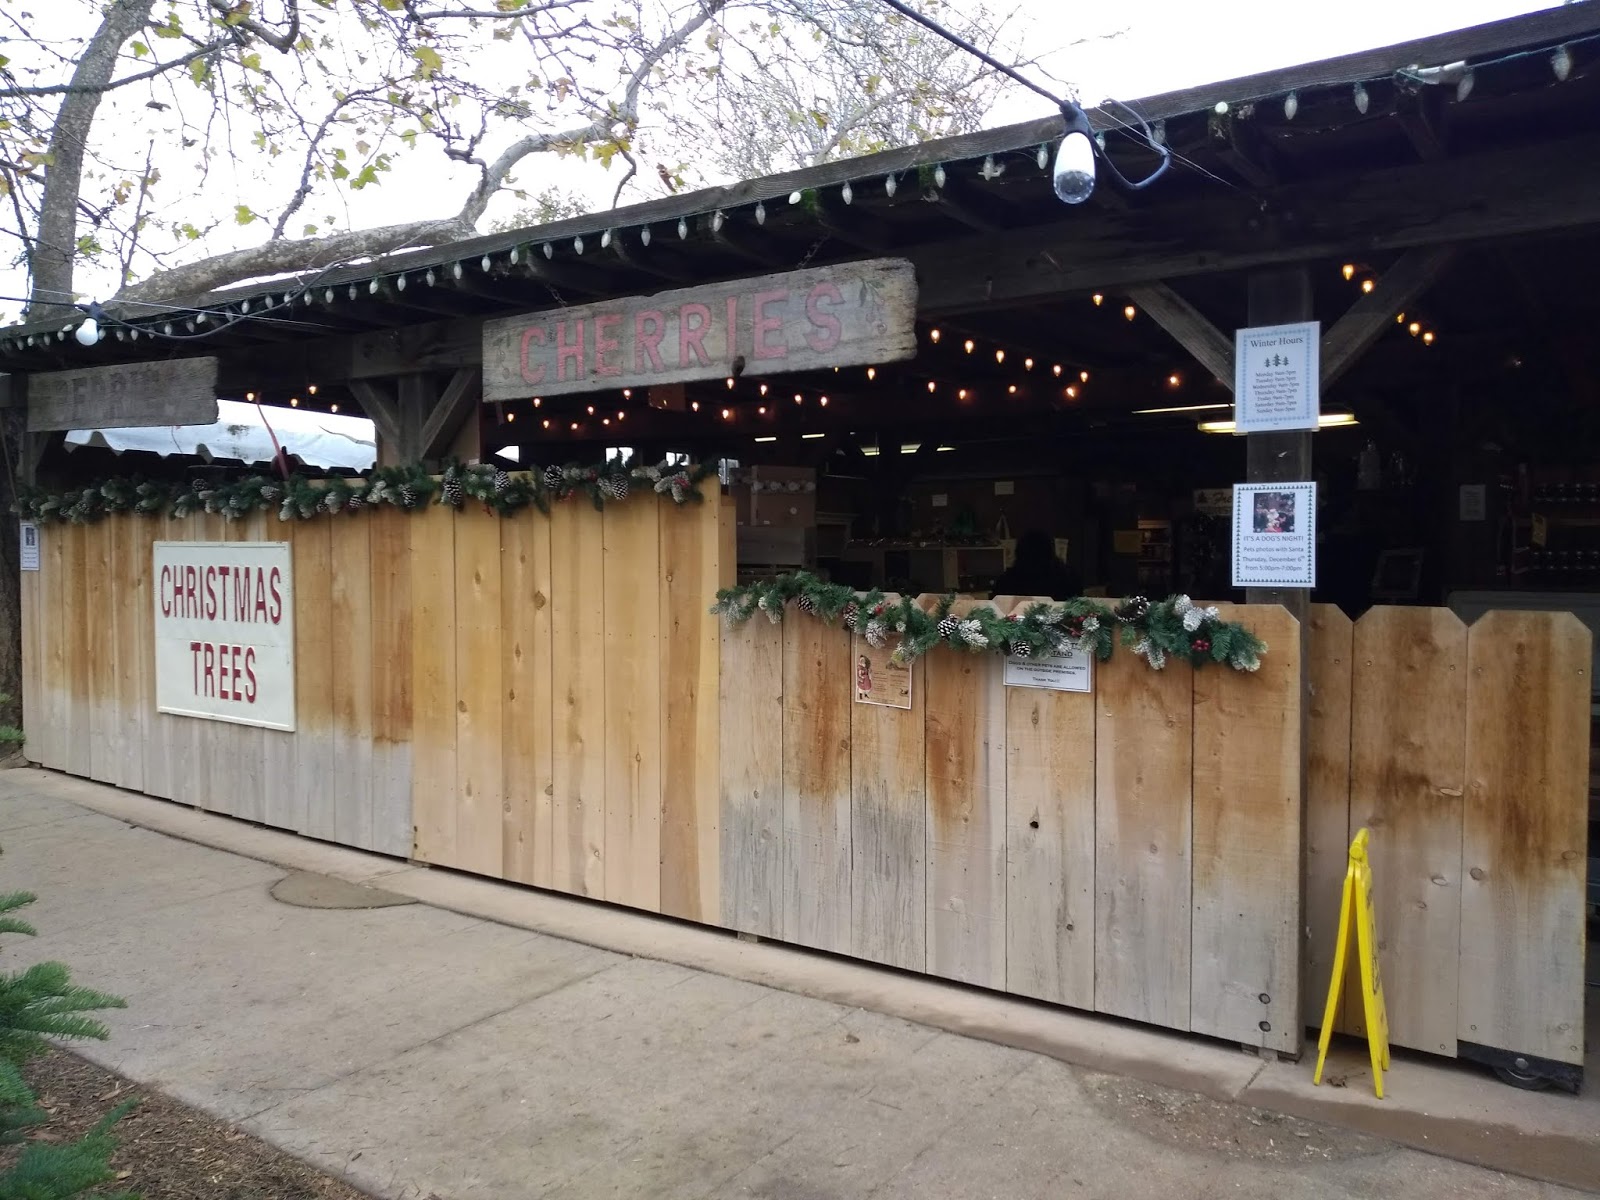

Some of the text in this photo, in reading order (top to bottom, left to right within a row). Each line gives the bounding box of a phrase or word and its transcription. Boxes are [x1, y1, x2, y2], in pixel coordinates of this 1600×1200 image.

[519, 282, 845, 386] CHERRIES
[1250, 336, 1304, 348] Winter Hours
[160, 564, 282, 625] CHRISTMAS
[190, 641, 257, 704] TREES
